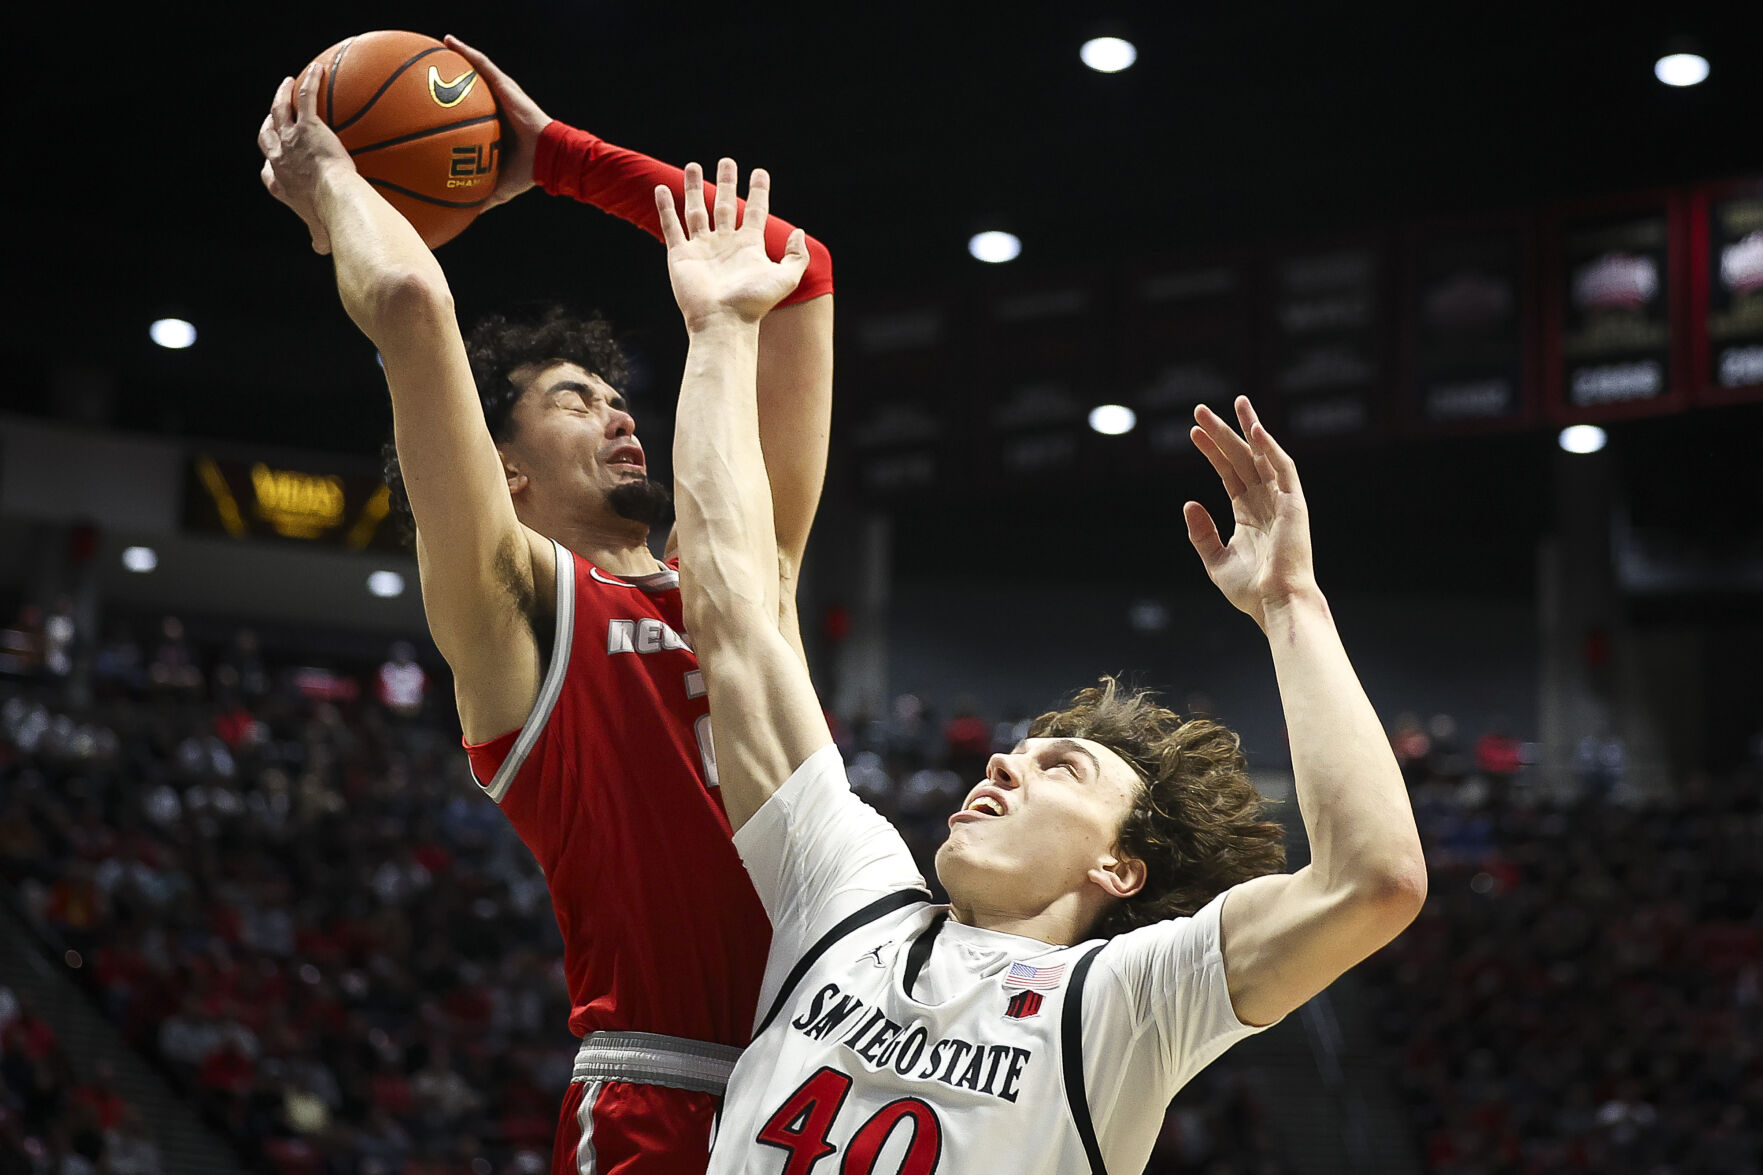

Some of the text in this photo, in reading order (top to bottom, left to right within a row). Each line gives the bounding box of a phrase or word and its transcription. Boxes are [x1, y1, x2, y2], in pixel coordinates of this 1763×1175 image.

[792, 983, 863, 1040] SAN
[919, 1039, 1031, 1103] STATE
[756, 1066, 942, 1175] 40
